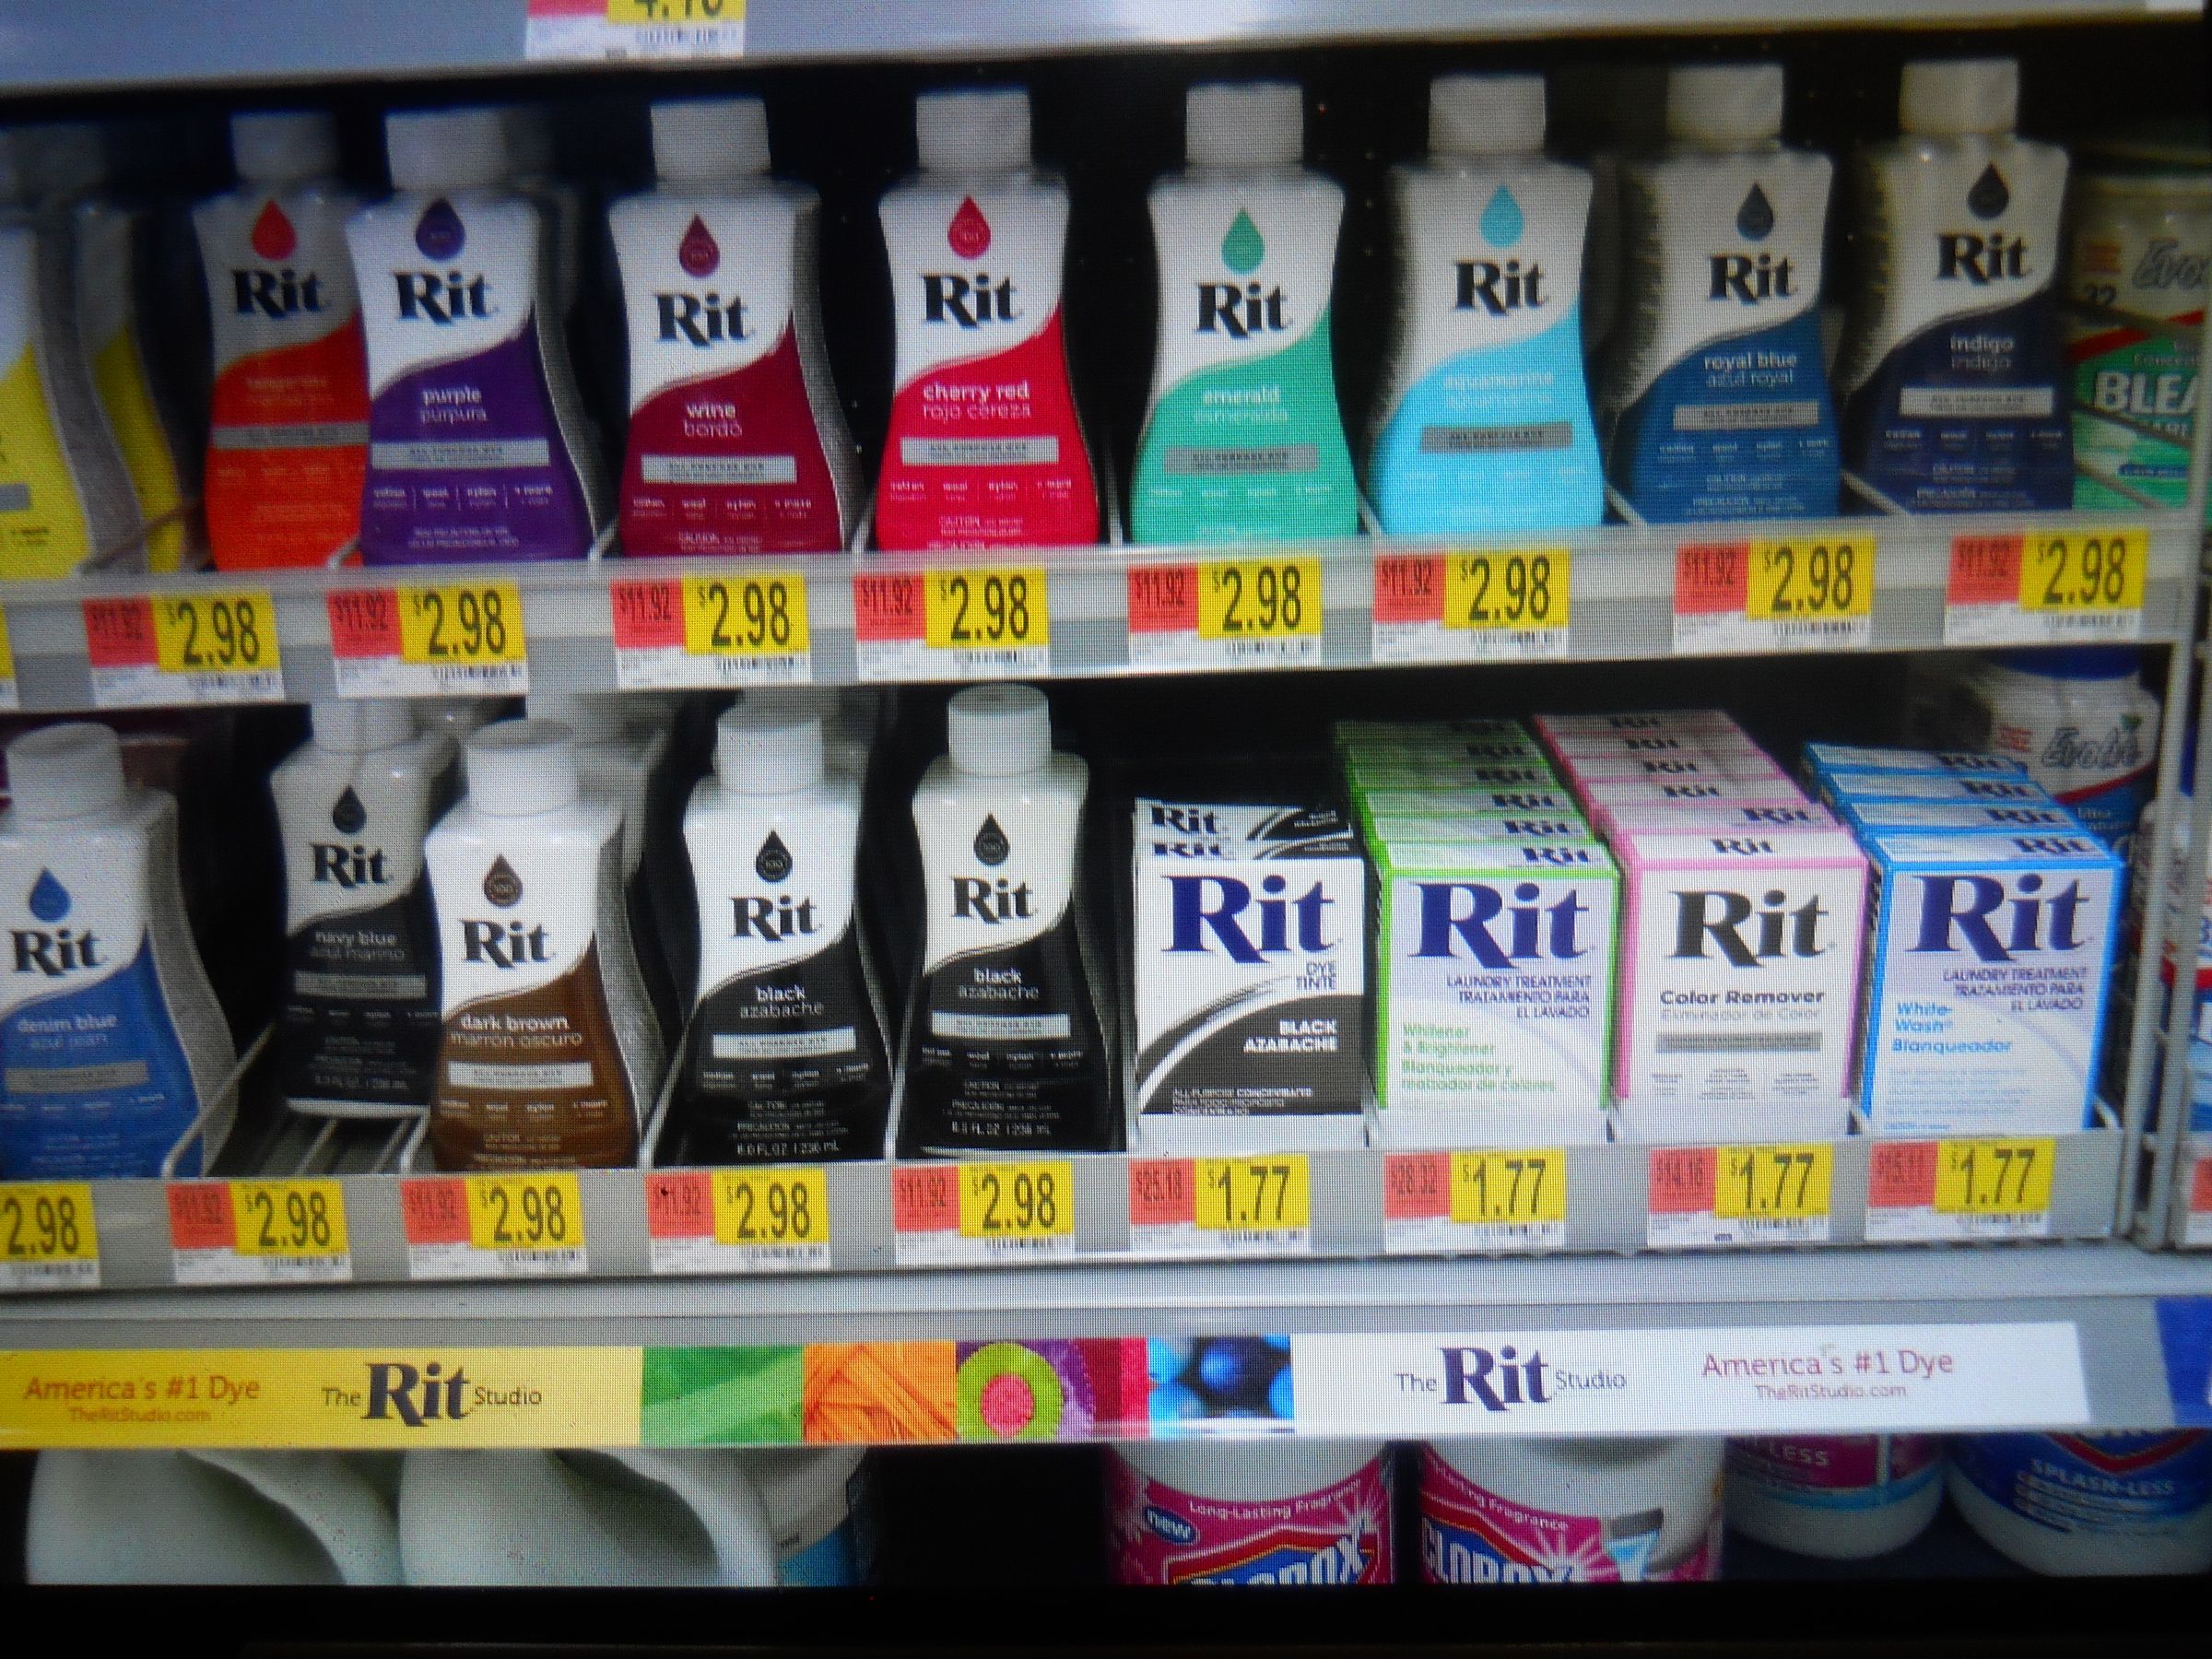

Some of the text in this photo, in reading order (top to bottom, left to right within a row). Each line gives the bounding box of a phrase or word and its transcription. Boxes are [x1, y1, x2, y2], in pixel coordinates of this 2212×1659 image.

[1937, 232, 2028, 286] Rit
[232, 268, 323, 319] Rit
[1453, 258, 1547, 316] Rit
[1710, 253, 1794, 305] Rit
[394, 271, 491, 325] Rit
[923, 273, 1018, 331] Rit
[1196, 281, 1288, 340] Rit
[654, 292, 748, 347] Rit
[1705, 348, 1797, 373] royal blue
[1950, 334, 2015, 356] indigo
[422, 385, 482, 408] purple
[686, 402, 736, 419] wine
[924, 379, 1030, 406] cherry red
[1203, 384, 1280, 405] emerald
[923, 404, 1031, 424] rojo cereza
[1135, 569, 1184, 606] $11.92
[1382, 559, 1433, 596] $11.92
[1460, 555, 1551, 622] $2.98
[1764, 544, 1853, 613] $2.98
[2036, 537, 2126, 606] $2.98
[618, 583, 672, 621] $11.92
[698, 582, 791, 648] $2.98
[861, 578, 913, 616] $11.92
[940, 576, 1029, 641] $2.98
[1213, 564, 1302, 632] $2.98
[168, 597, 262, 666] $2.98
[414, 589, 507, 656] $2.98
[1152, 806, 1217, 835] Rit
[311, 842, 388, 889] Rit
[1523, 848, 1590, 865] Rit
[1712, 839, 1772, 855] Rit
[730, 894, 818, 942] Rit
[951, 876, 1034, 924] Rit
[1904, 873, 2090, 961] Rit
[314, 928, 396, 948] navy blue
[1160, 875, 1335, 964] Rit
[1407, 882, 1594, 969] Rit
[1665, 889, 1830, 968] Rit
[11, 929, 102, 976] Rit
[459, 920, 550, 969] Rit
[973, 968, 1021, 983] black
[1306, 961, 1336, 976] DYE
[1447, 974, 1591, 988] LAUNDRY TREATMENT
[1943, 967, 2087, 982] LAUNDRY TREATMENT
[756, 985, 806, 1003] black
[959, 982, 1039, 1001] azabache
[1459, 991, 1590, 1004] TRATAMIENTO PARA
[1660, 989, 1826, 1005] Color Remover
[1955, 983, 2084, 996] TRATAMIENTO PARA
[2011, 999, 2084, 1012] EL LAVADO
[18, 1013, 118, 1033] denim blue
[461, 1013, 502, 1031] dark
[507, 1012, 570, 1031] brown
[740, 1001, 823, 1018] azabache
[1279, 1019, 1337, 1035] BLACK
[1517, 1006, 1590, 1018] EL LAVADO
[521, 1032, 582, 1048] oscuro
[1243, 1036, 1339, 1052] AZABACHE
[1403, 1023, 1470, 1038] Whitener
[1892, 1039, 2011, 1054] Blanqueador
[1402, 1060, 1499, 1077] Blanqueador
[1207, 1164, 1290, 1223] $1.77
[1462, 1158, 1547, 1217] $1.77
[1729, 1152, 1815, 1211] $1.77
[1950, 1147, 2035, 1206] $1.77
[481, 1185, 568, 1244] $2.98
[726, 1181, 811, 1241] $2.98
[972, 1172, 1057, 1231] $2.98
[6, 1195, 79, 1256] 2.98
[245, 1190, 332, 1253] $2.98
[1396, 1345, 1627, 1412] The Rit Studio
[1701, 1350, 1954, 1379] America's #1 Dye
[23, 1375, 260, 1405] America's #1 Dye
[322, 1361, 542, 1428] The Rit Studio
[1756, 1383, 1907, 1401] TheRitStudio.com
[69, 1407, 212, 1424] TheRitStudio.com
[1149, 1511, 1192, 1540] new
[1189, 1500, 1292, 1520] Long-Lasting
